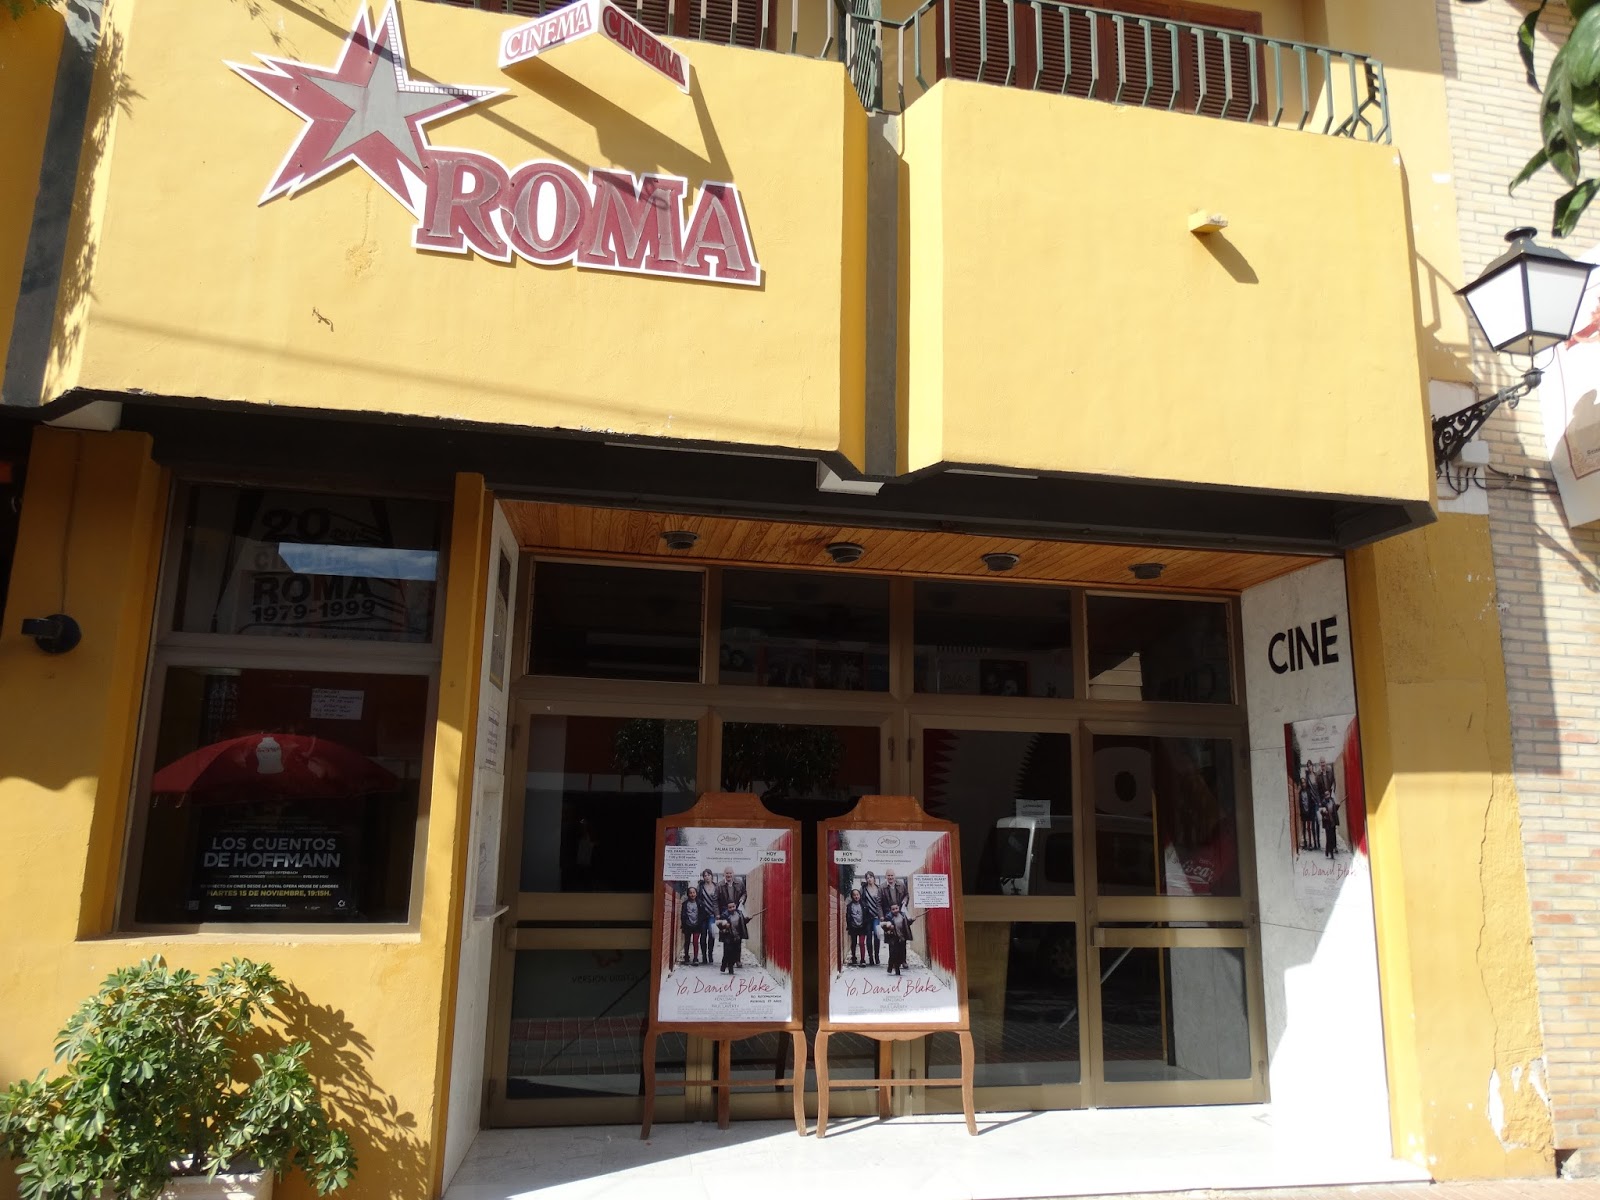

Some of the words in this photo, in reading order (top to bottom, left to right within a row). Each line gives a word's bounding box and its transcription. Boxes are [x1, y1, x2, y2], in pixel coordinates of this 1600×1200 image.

[503, 2, 592, 60] CINEMA
[603, 4, 688, 88] CINEMA
[417, 148, 758, 283] ROMA
[253, 575, 371, 605] ROMA
[252, 600, 376, 622] 1979-1999
[1268, 615, 1339, 674] CINE
[212, 837, 247, 850] LOS
[252, 837, 336, 851] CUENTOS
[203, 852, 231, 867] DE
[233, 852, 341, 868] HOFFMANN
[676, 976, 689, 996] Yo,
[693, 976, 735, 994] Daniel
[736, 976, 775, 997] Blake
[844, 978, 859, 997] Yo,
[862, 976, 902, 995] Daniel
[903, 976, 942, 997] Blake
